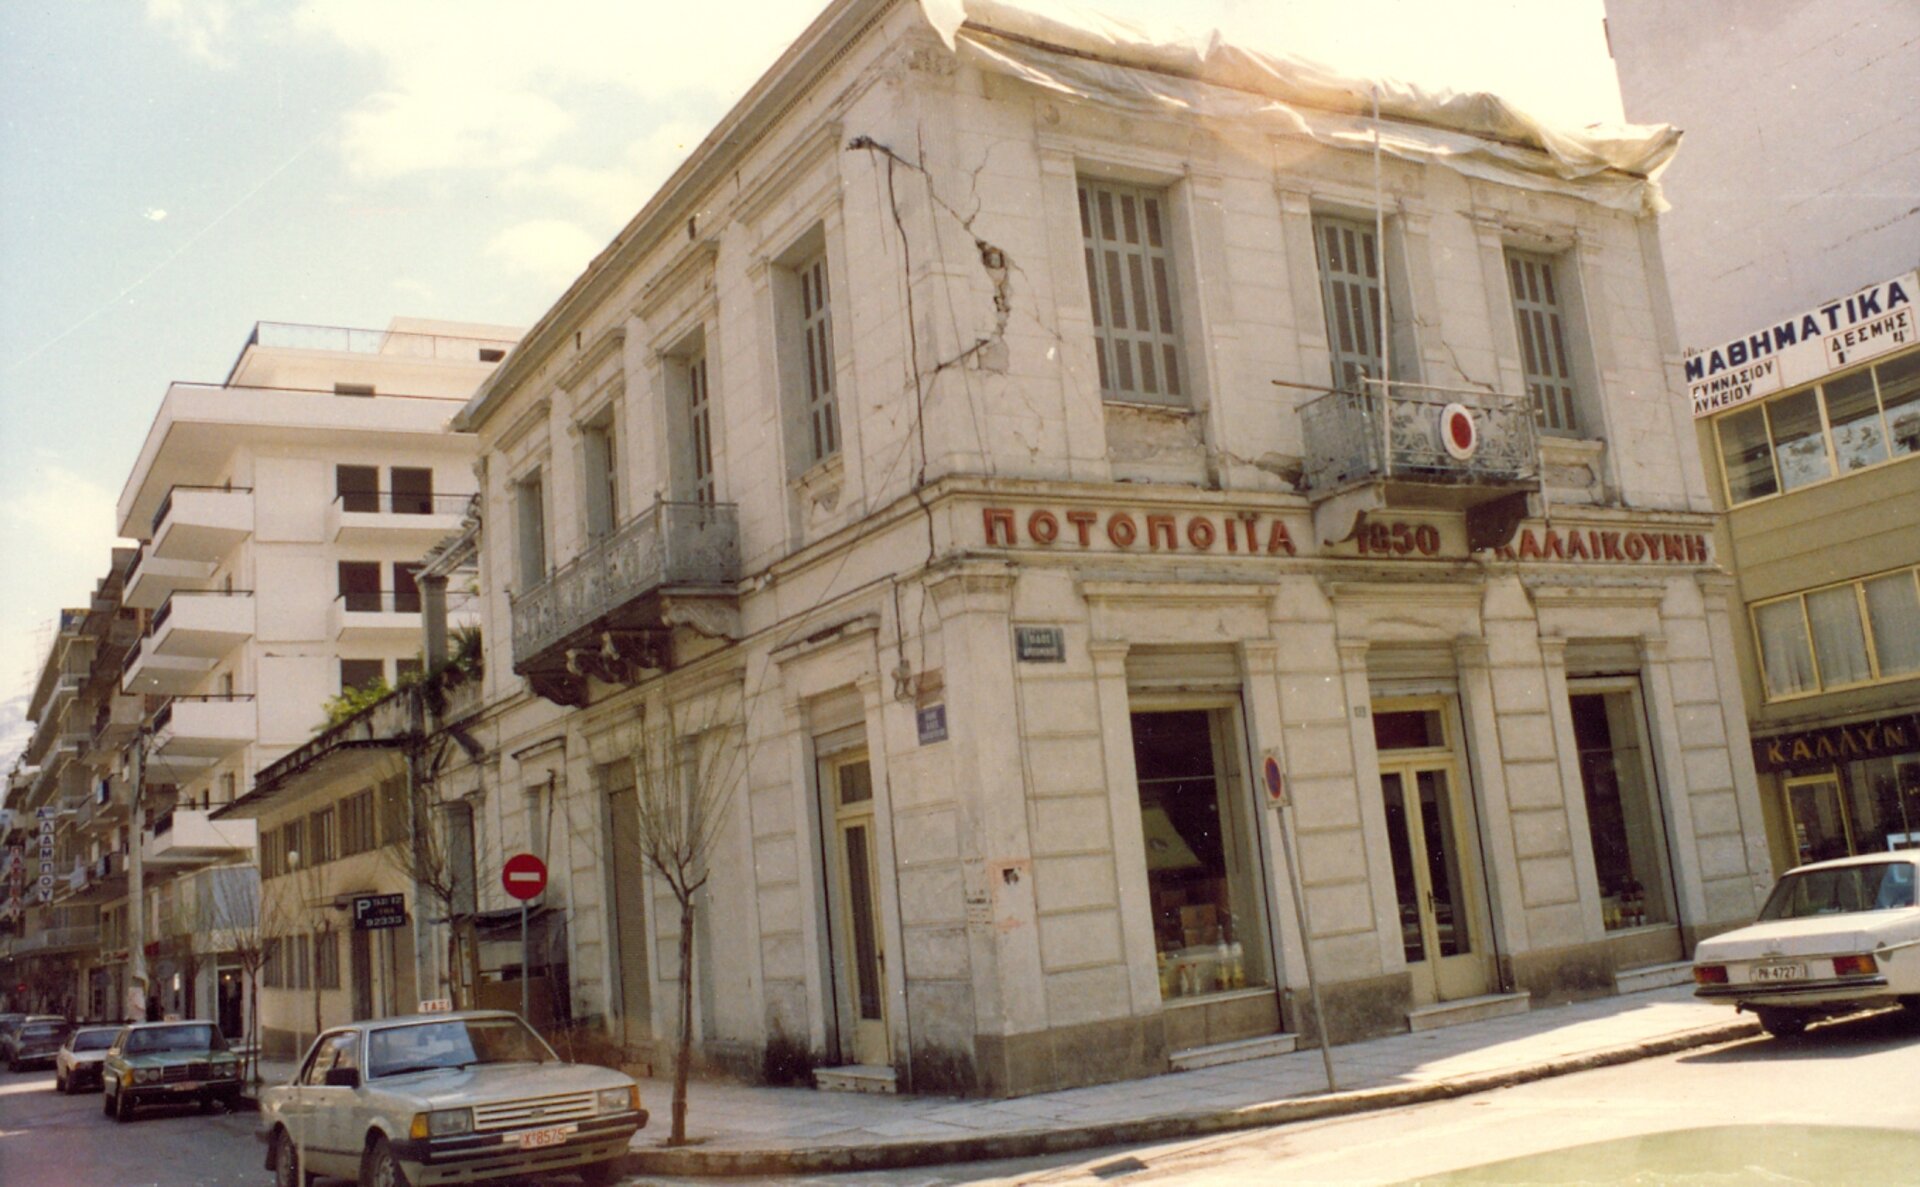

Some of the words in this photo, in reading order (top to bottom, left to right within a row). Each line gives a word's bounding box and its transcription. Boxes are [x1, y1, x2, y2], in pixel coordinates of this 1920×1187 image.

[1684, 281, 1909, 382] ΜΑΘΗΜΑΤΙΚΑ
[1832, 312, 1907, 352] ΔΕΣΜΗΣ
[1695, 383, 1752, 413] ΛΥΚΕΙΟΥ
[1768, 724, 1920, 763] ΚΑΛΛΥΝ
